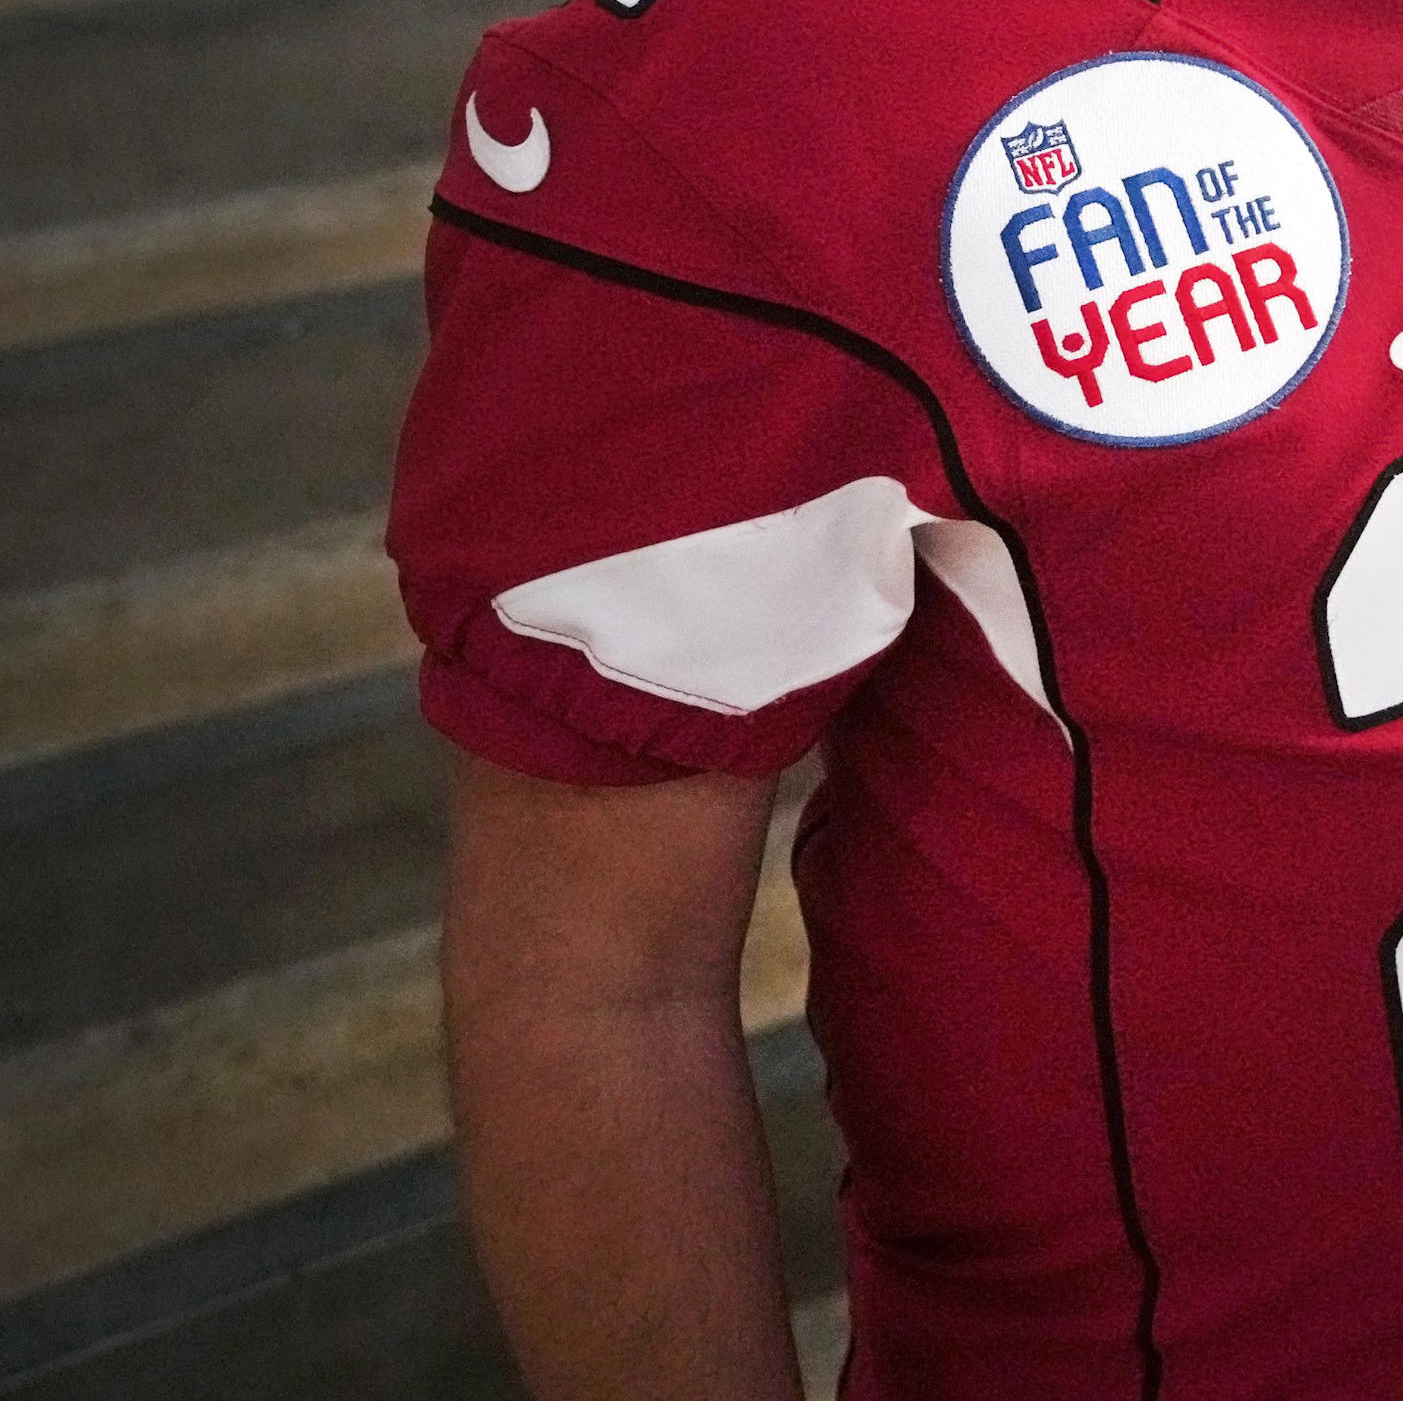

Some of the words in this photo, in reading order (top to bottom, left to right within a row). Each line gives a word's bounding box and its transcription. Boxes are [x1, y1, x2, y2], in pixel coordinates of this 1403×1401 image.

[1015, 148, 1075, 188] NFL
[1197, 160, 1239, 202] OF
[1000, 167, 1209, 313] FAN
[1211, 195, 1281, 245] THE
[1030, 242, 1319, 408] YEAR
